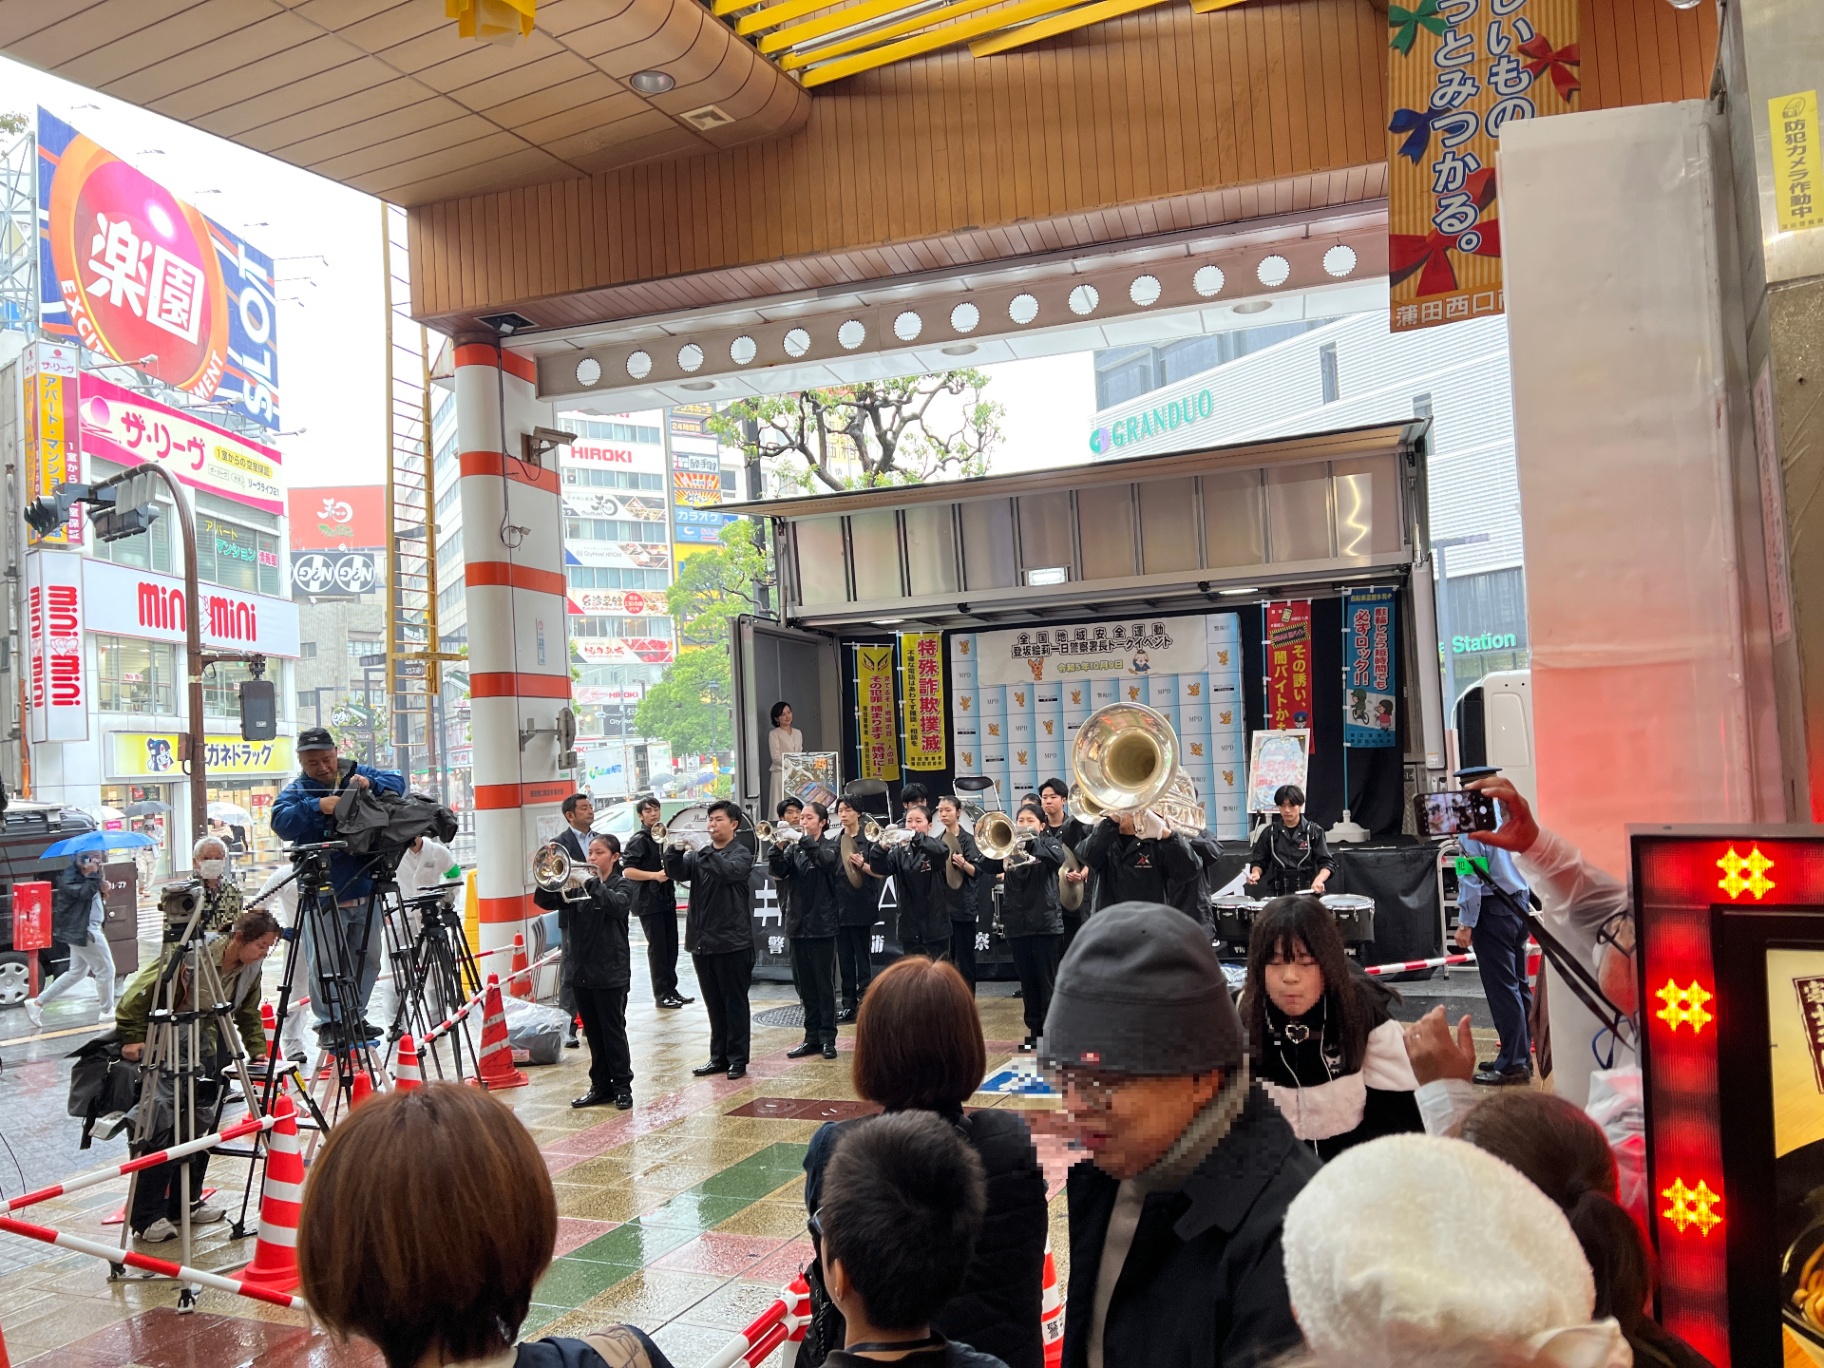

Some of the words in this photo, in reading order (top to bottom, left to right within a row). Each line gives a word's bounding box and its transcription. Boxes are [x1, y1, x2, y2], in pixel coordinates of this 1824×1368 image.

[1784, 119, 1813, 218] 防犯カメラ作動中
[85, 212, 205, 345] 楽園
[238, 242, 273, 423] SLOT
[1396, 288, 1504, 328] 蒲田西口
[121, 410, 206, 471] ザ・リーヴ
[1111, 389, 1213, 447] GRANDUO
[571, 446, 632, 463] HIROKI
[205, 520, 238, 540] アパート
[678, 511, 718, 522] カラオケ
[216, 538, 256, 561] マンション
[48, 585, 79, 637] mini
[138, 581, 186, 632] min
[210, 595, 257, 642] mini
[1057, 660, 1123, 673] 令和5年10月9日
[1373, 606, 1389, 690] 駐輪したら短時間でも
[1452, 632, 1516, 653] Station
[51, 655, 81, 706] mini
[917, 639, 942, 752] 特殊詐欺撲滅
[1292, 644, 1307, 707] その誘い、
[205, 743, 275, 767] ガネドラッグ
